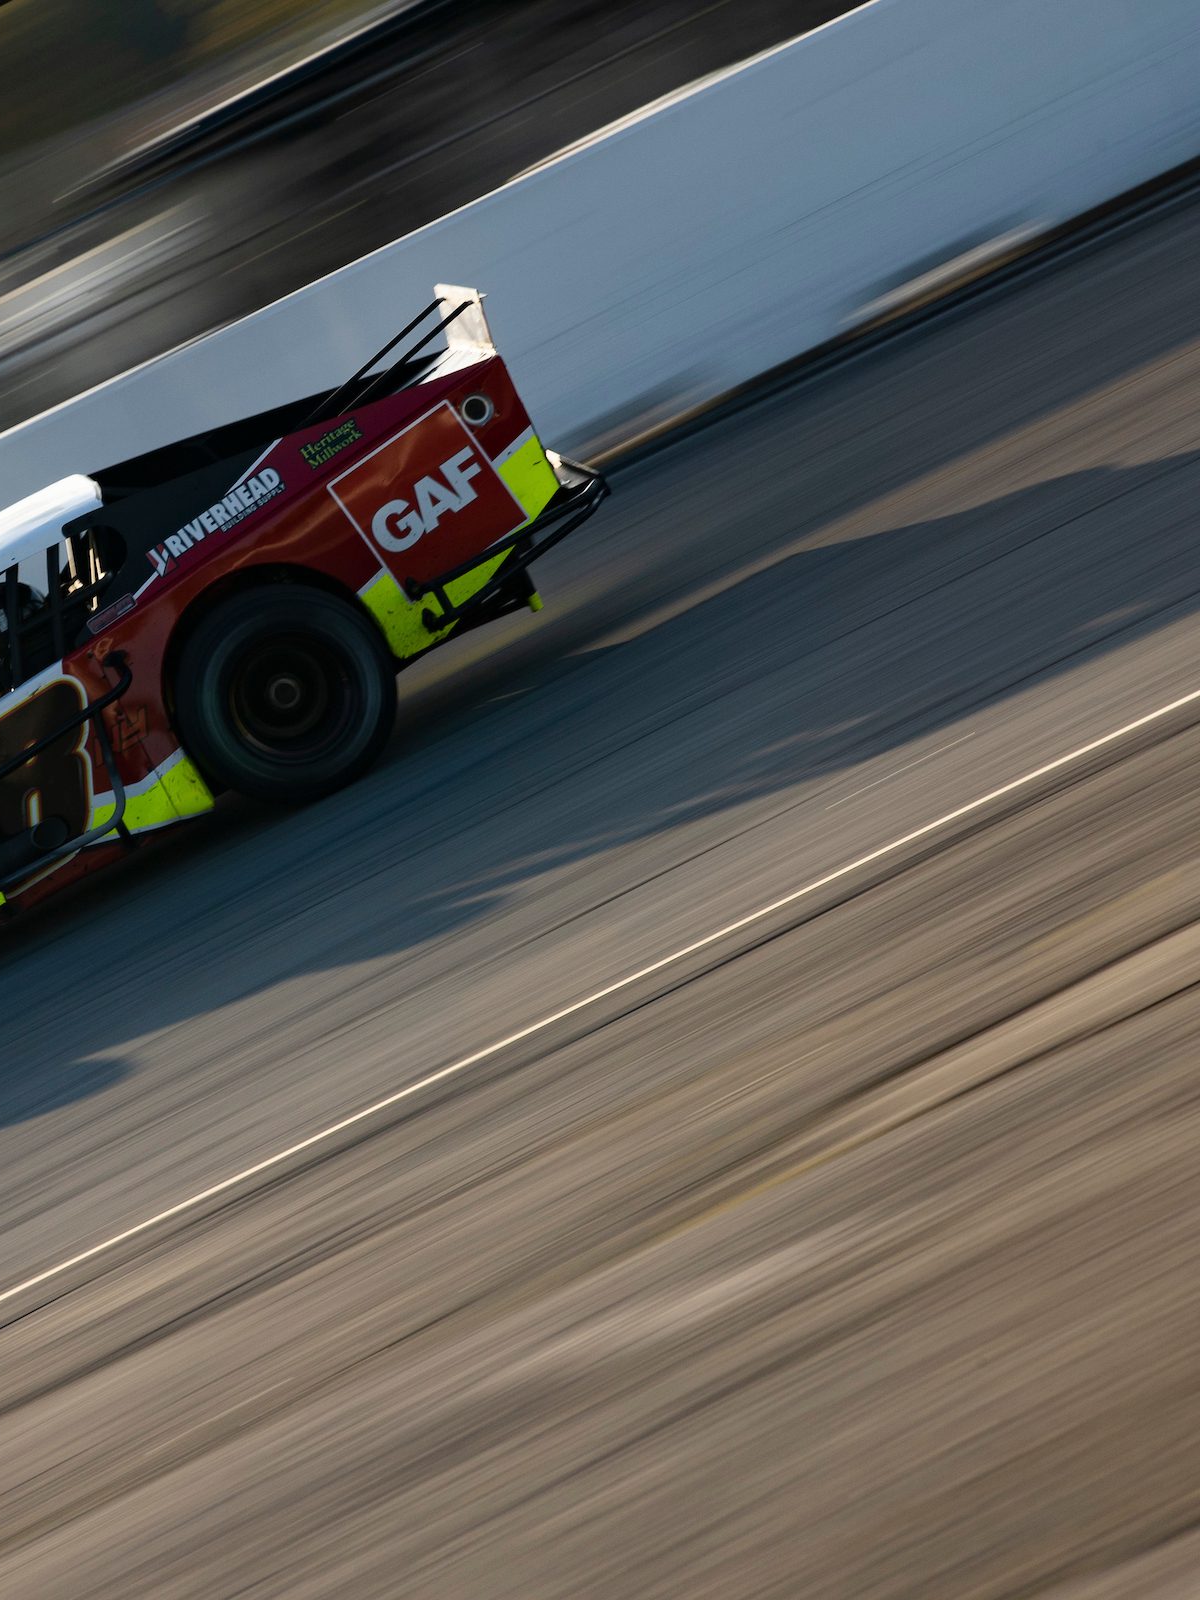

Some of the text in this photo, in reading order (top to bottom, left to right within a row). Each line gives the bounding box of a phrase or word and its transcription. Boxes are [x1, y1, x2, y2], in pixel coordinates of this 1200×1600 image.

[301, 420, 356, 459] Heritage
[308, 431, 363, 470] Millwork
[164, 467, 281, 558] RIVERHEAD
[221, 481, 286, 533] BUILDING SUPPLY
[371, 445, 482, 553] GAF
